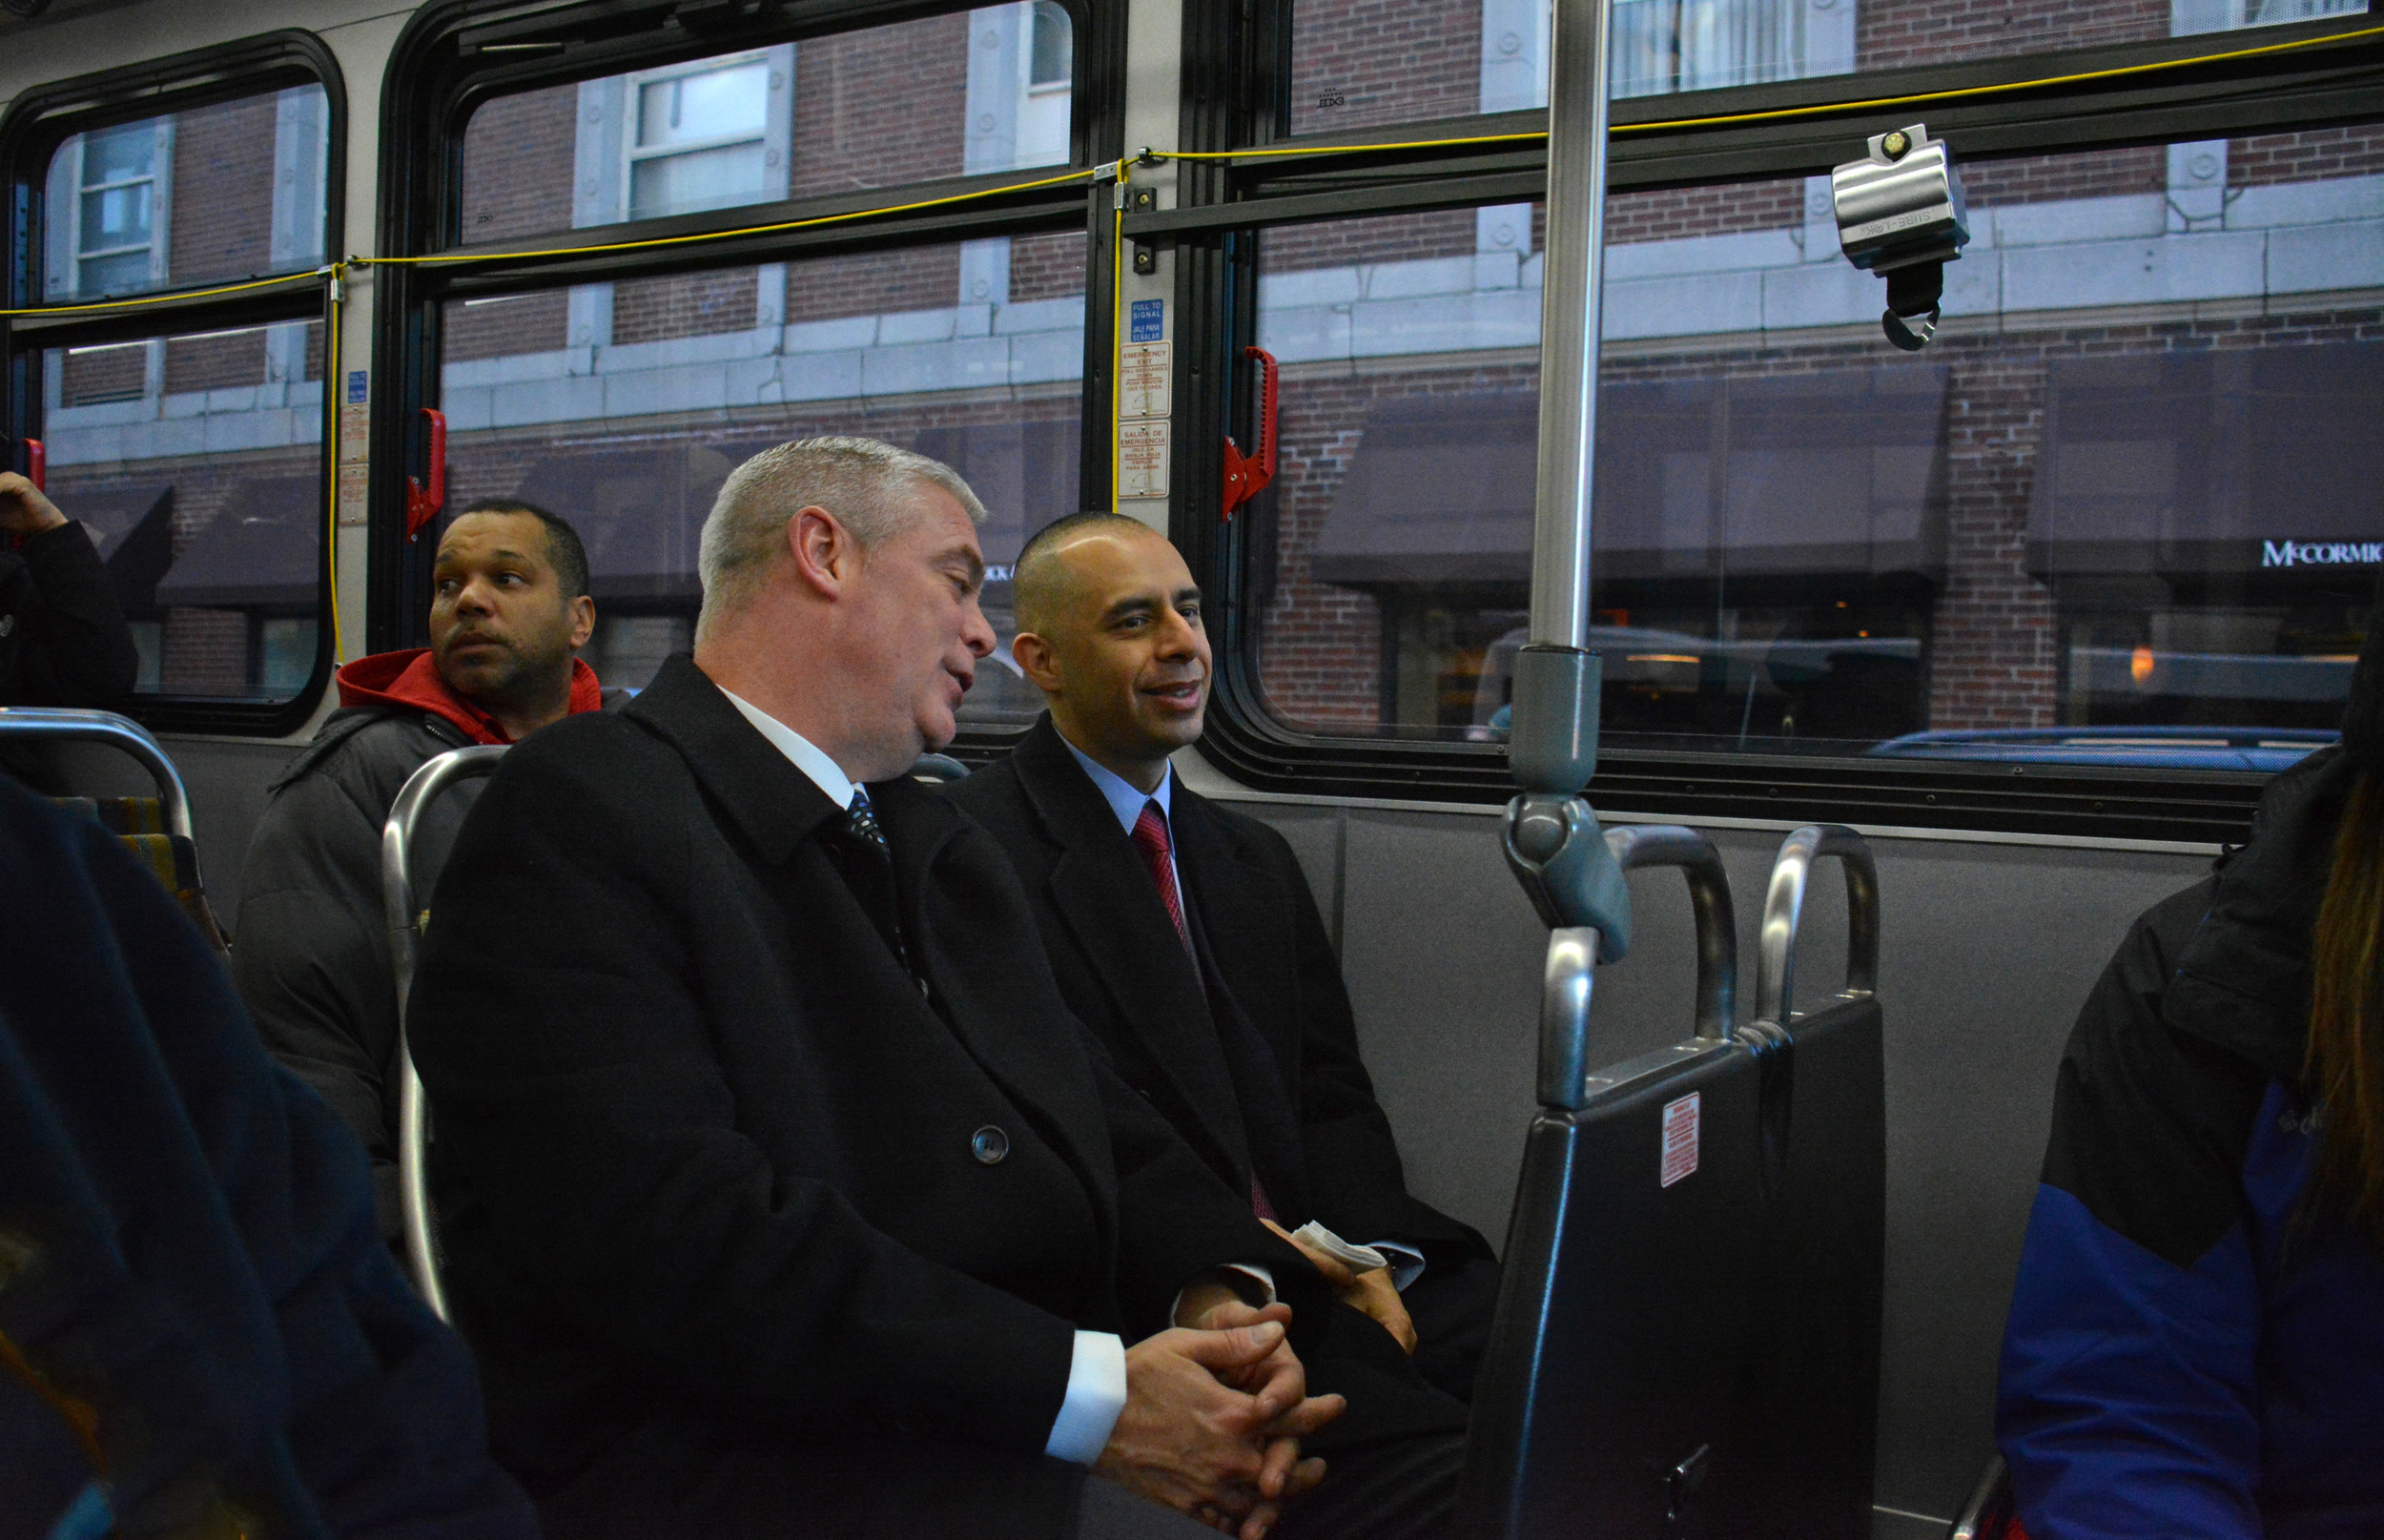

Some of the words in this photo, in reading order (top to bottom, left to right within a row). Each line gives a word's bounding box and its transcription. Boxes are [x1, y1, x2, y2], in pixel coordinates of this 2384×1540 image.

[1132, 310, 1161, 319] SIGNAL
[1123, 350, 1167, 359] EMERGENCY
[1120, 437, 1166, 445] EMERGENCIA
